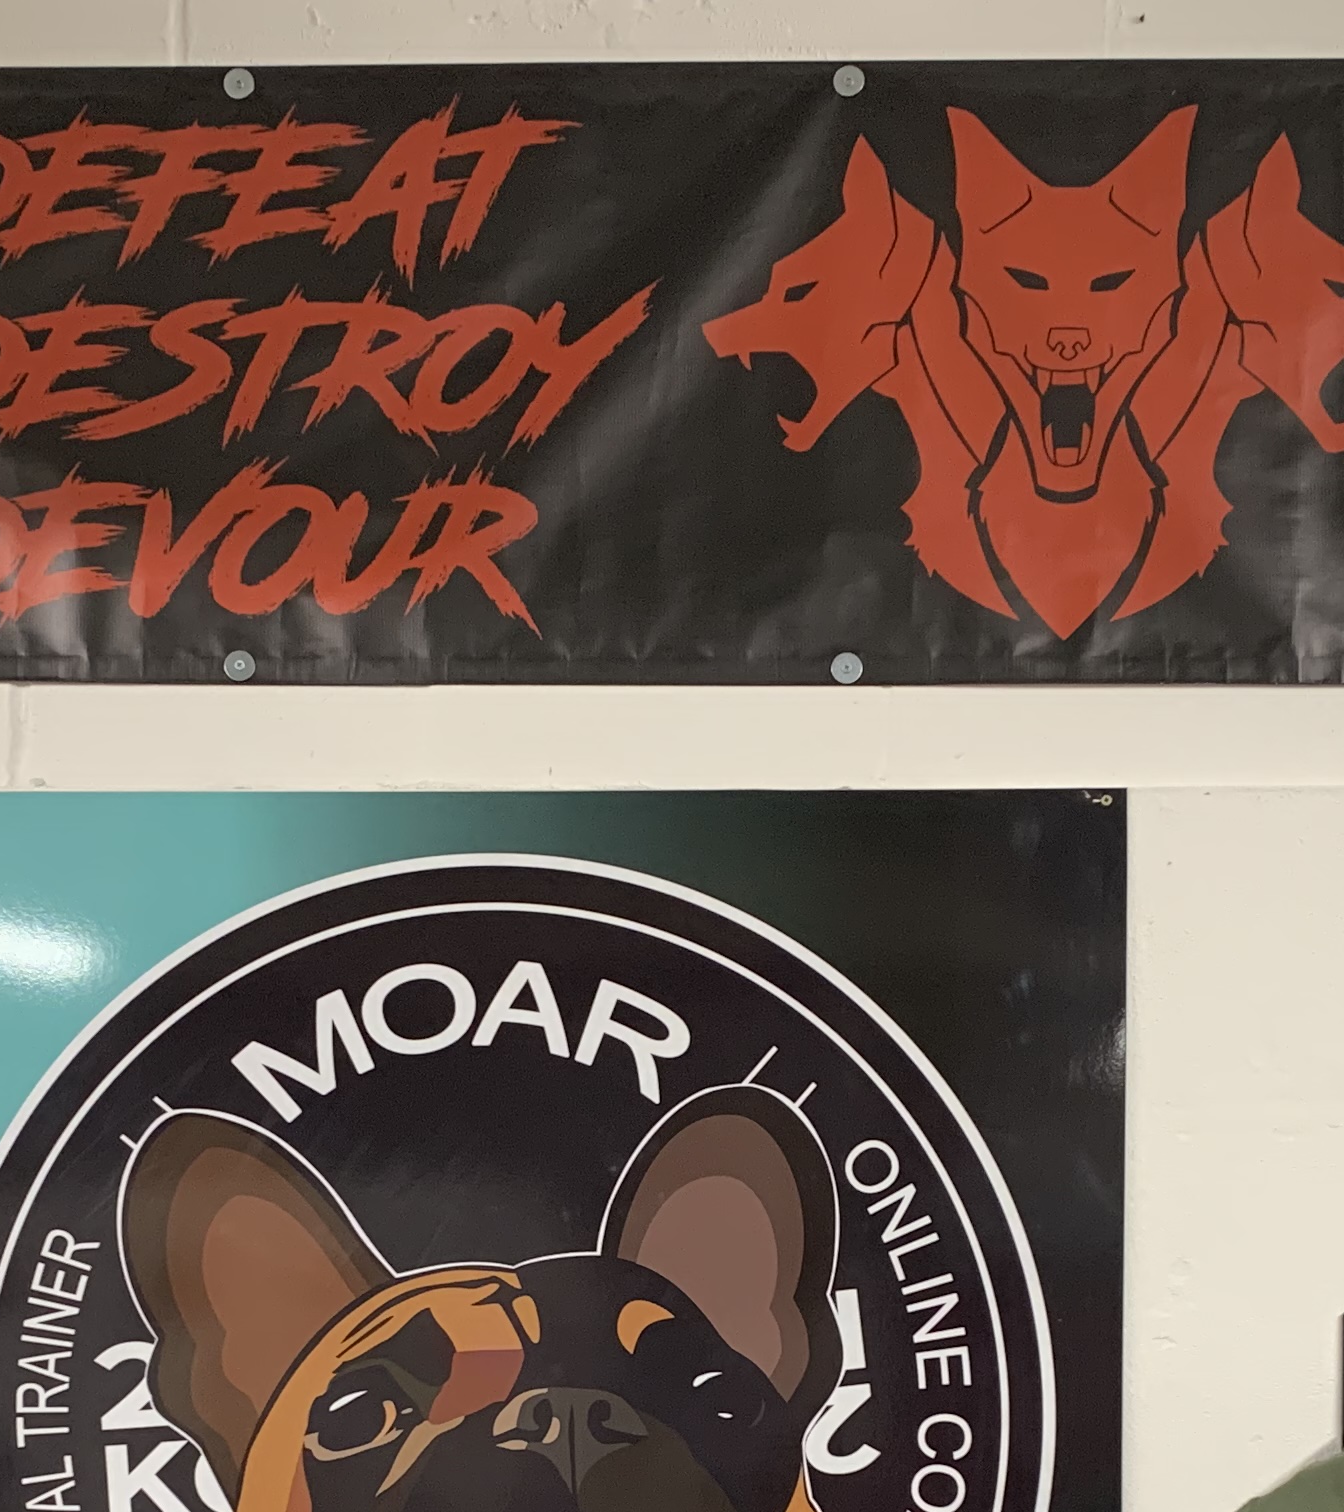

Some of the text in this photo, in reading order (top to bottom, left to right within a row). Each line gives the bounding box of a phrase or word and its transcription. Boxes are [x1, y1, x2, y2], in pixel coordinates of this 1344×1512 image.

[230, 961, 690, 1122] MOAR
[16, 1230, 100, 1447] TRAINER
[845, 1140, 971, 1385] ONLINE
